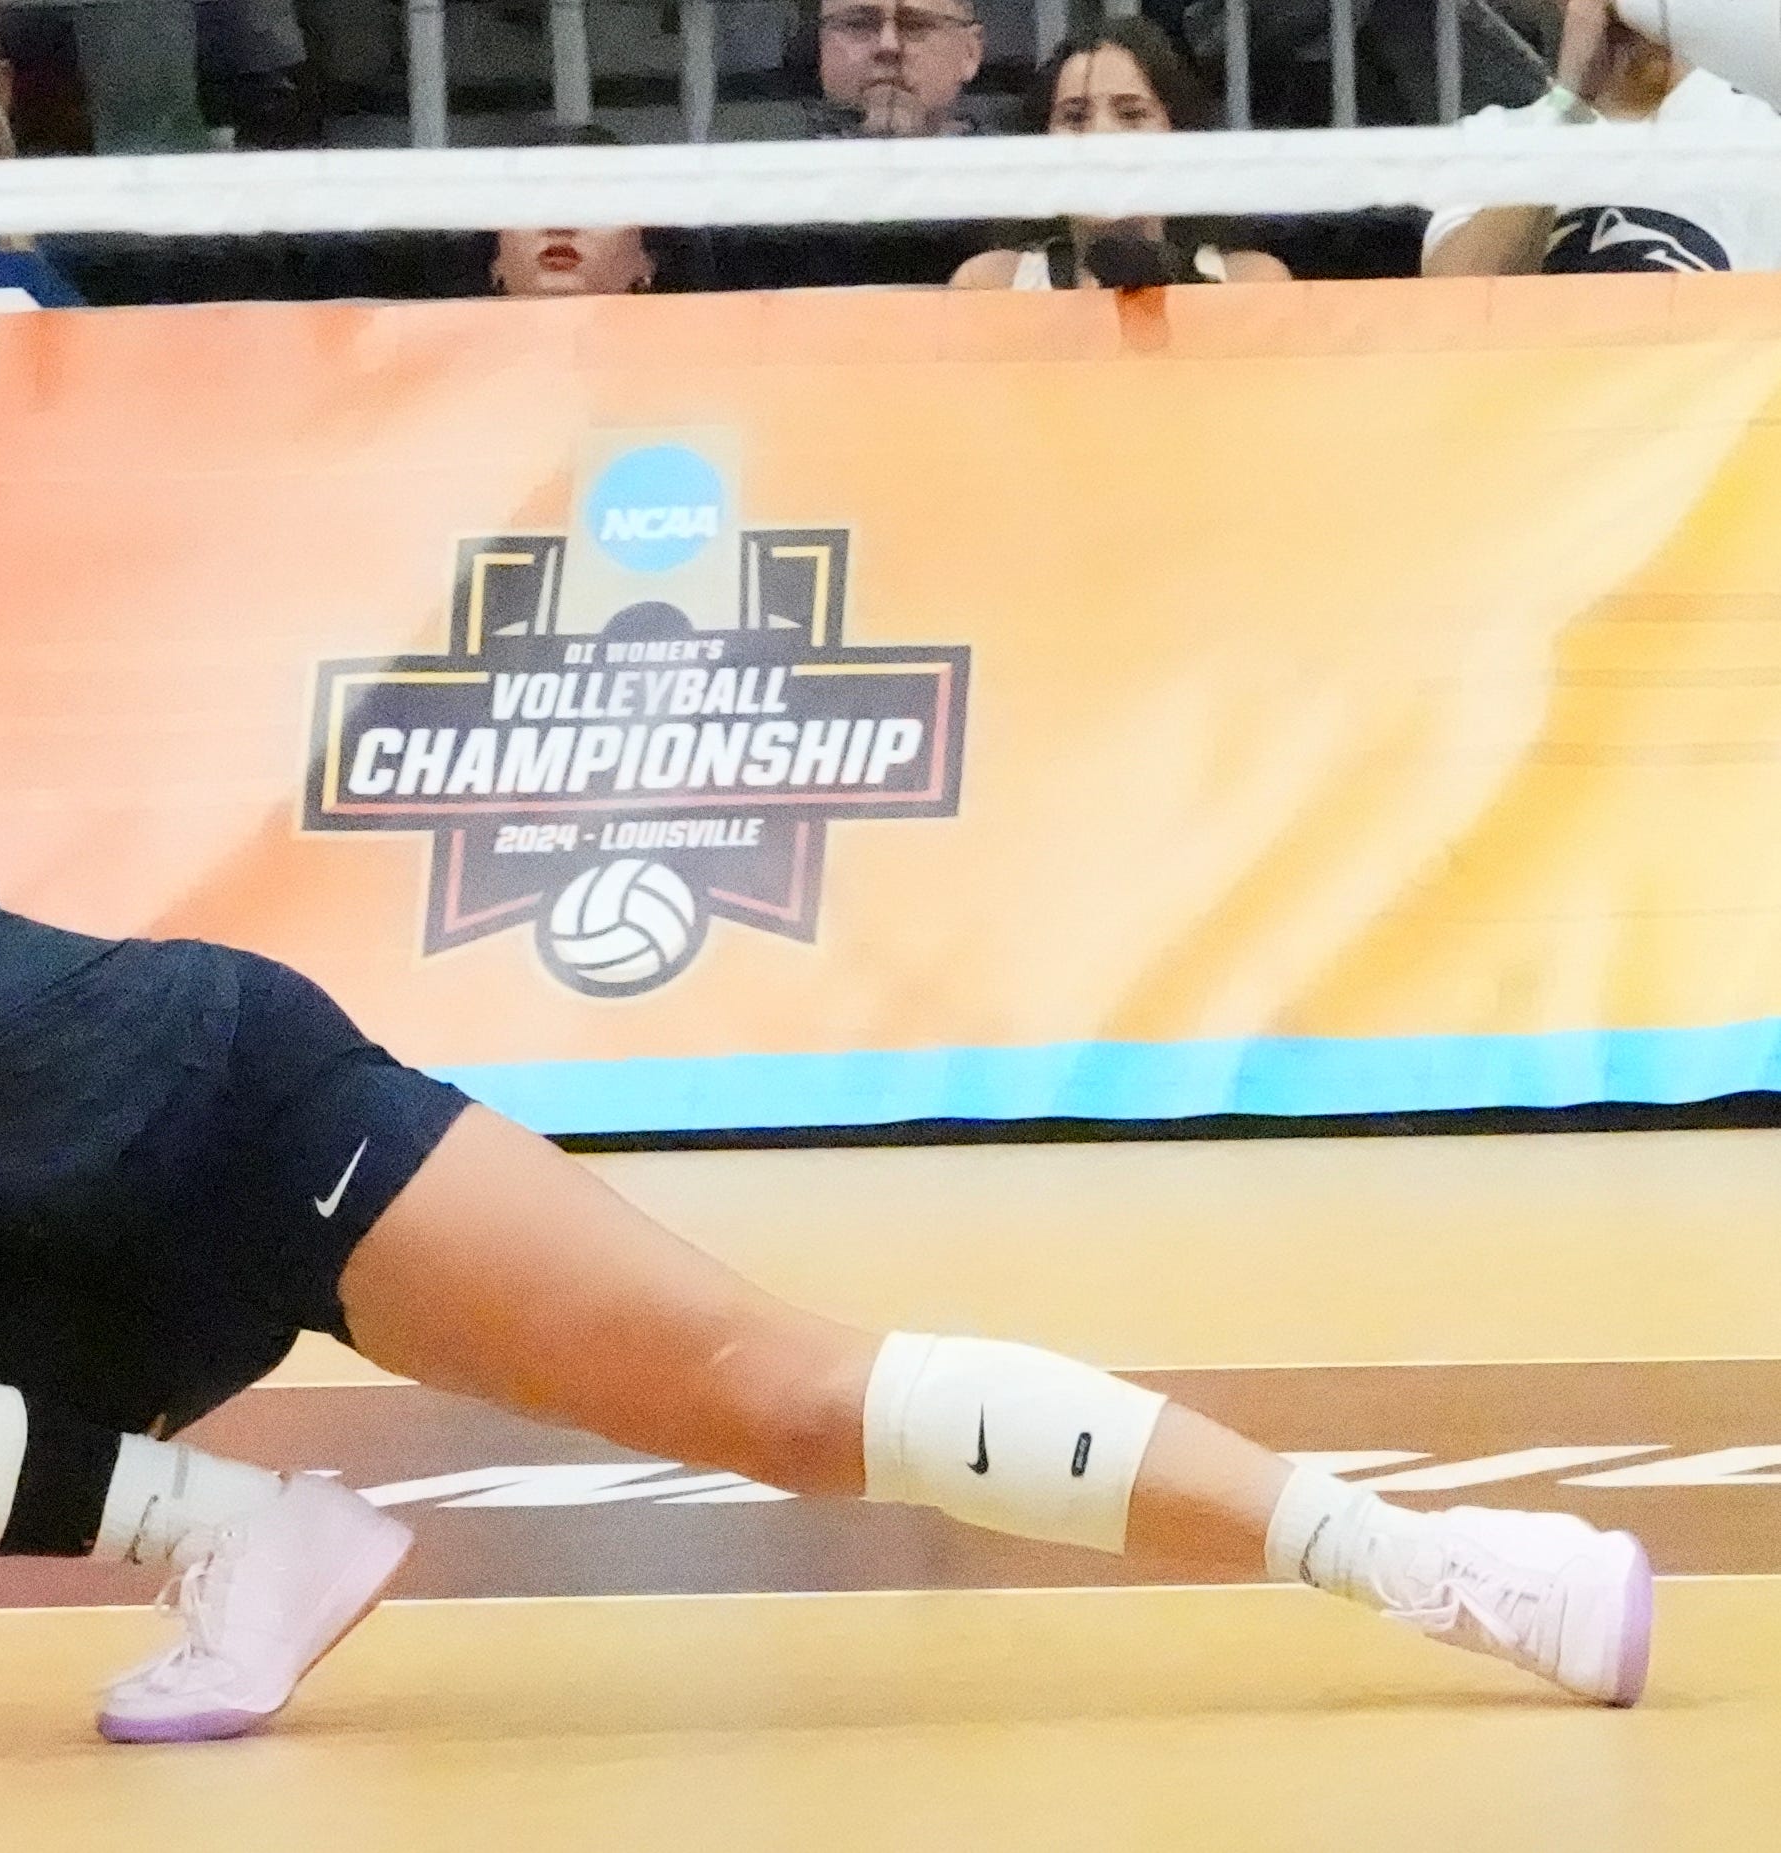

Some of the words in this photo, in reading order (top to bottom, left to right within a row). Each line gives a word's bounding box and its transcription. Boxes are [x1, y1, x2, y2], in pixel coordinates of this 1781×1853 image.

[600, 506, 718, 541] NCAA
[564, 643, 596, 664] DI
[605, 639, 724, 662] WOMEN'S
[492, 666, 787, 720] VOLLEYBALL
[347, 717, 923, 796] CHAMPIONSHIP
[494, 825, 578, 853] 2024
[599, 818, 765, 851] LOUISVILLE
